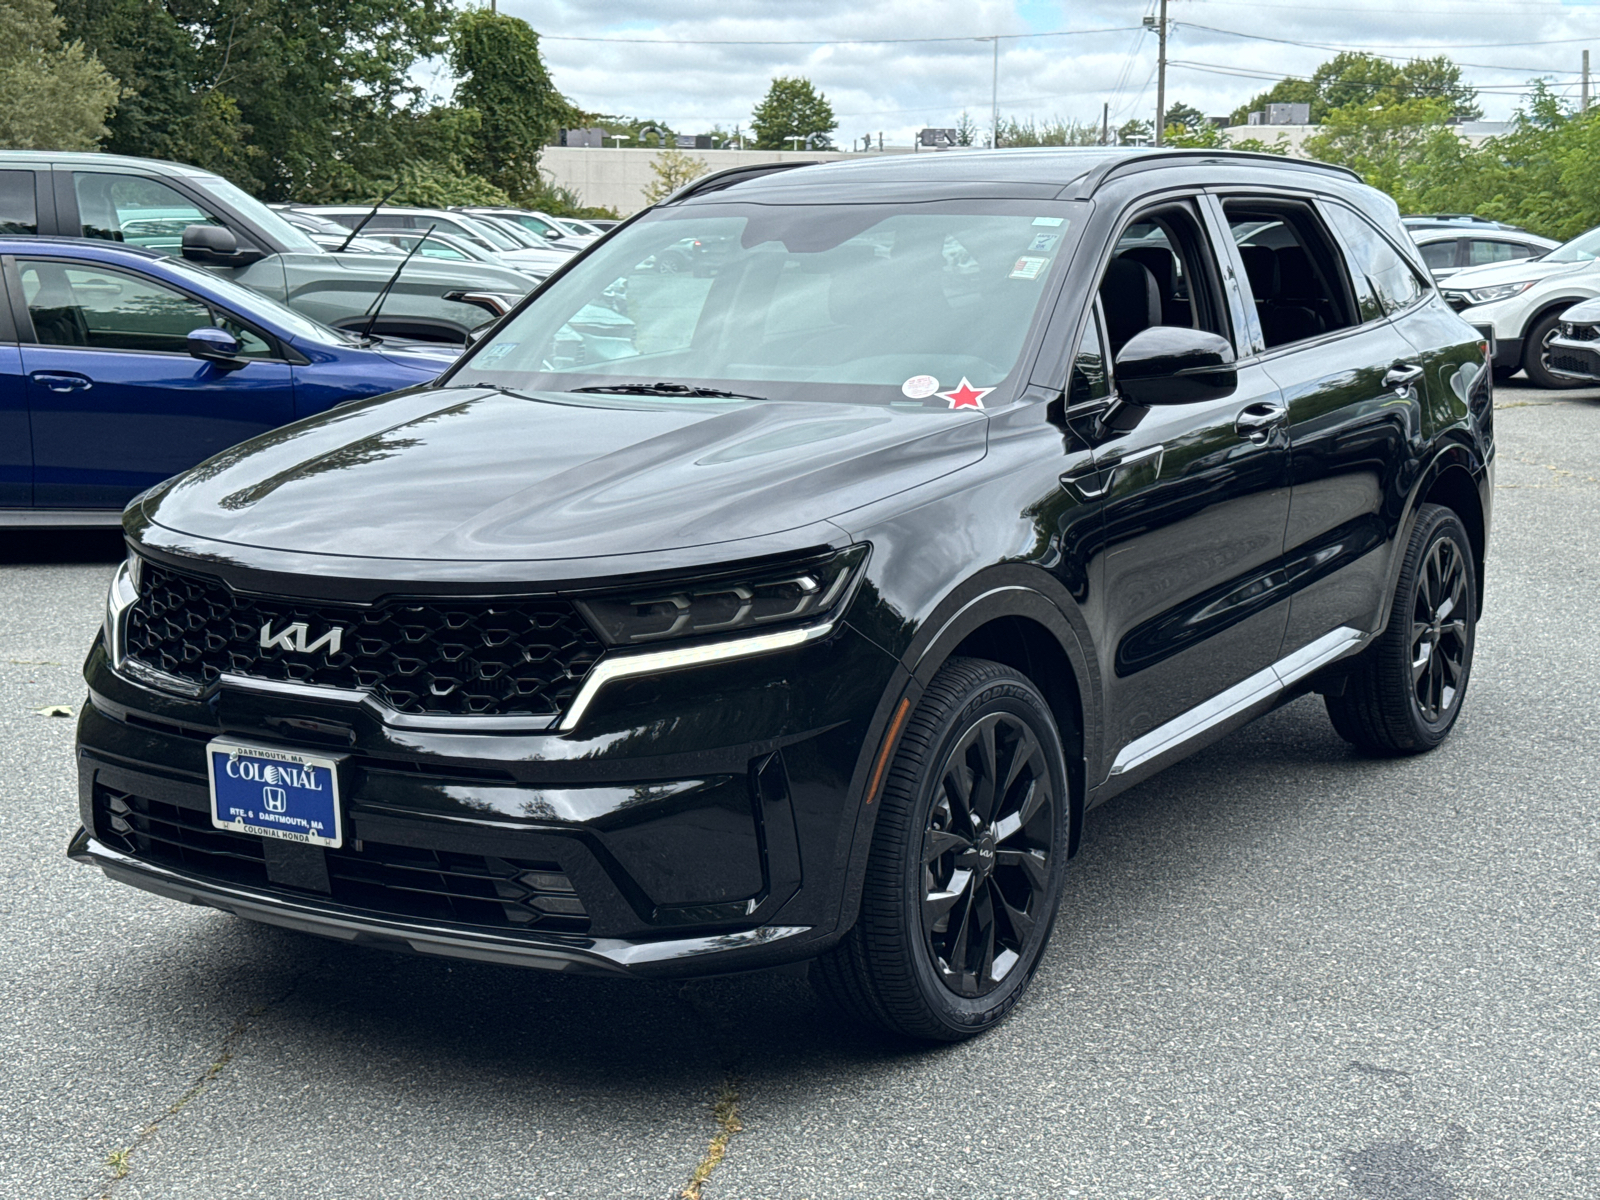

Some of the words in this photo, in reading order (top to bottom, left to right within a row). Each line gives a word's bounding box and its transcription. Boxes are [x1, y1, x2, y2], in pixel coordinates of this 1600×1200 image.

[290, 755, 303, 763] MA
[226, 759, 322, 791] COLONIAL
[229, 807, 247, 817] RTE.
[258, 811, 310, 828] DARTMOUTH,
[310, 820, 324, 830] MA
[243, 825, 280, 838] COLONIAL
[282, 833, 310, 843] HONDA
